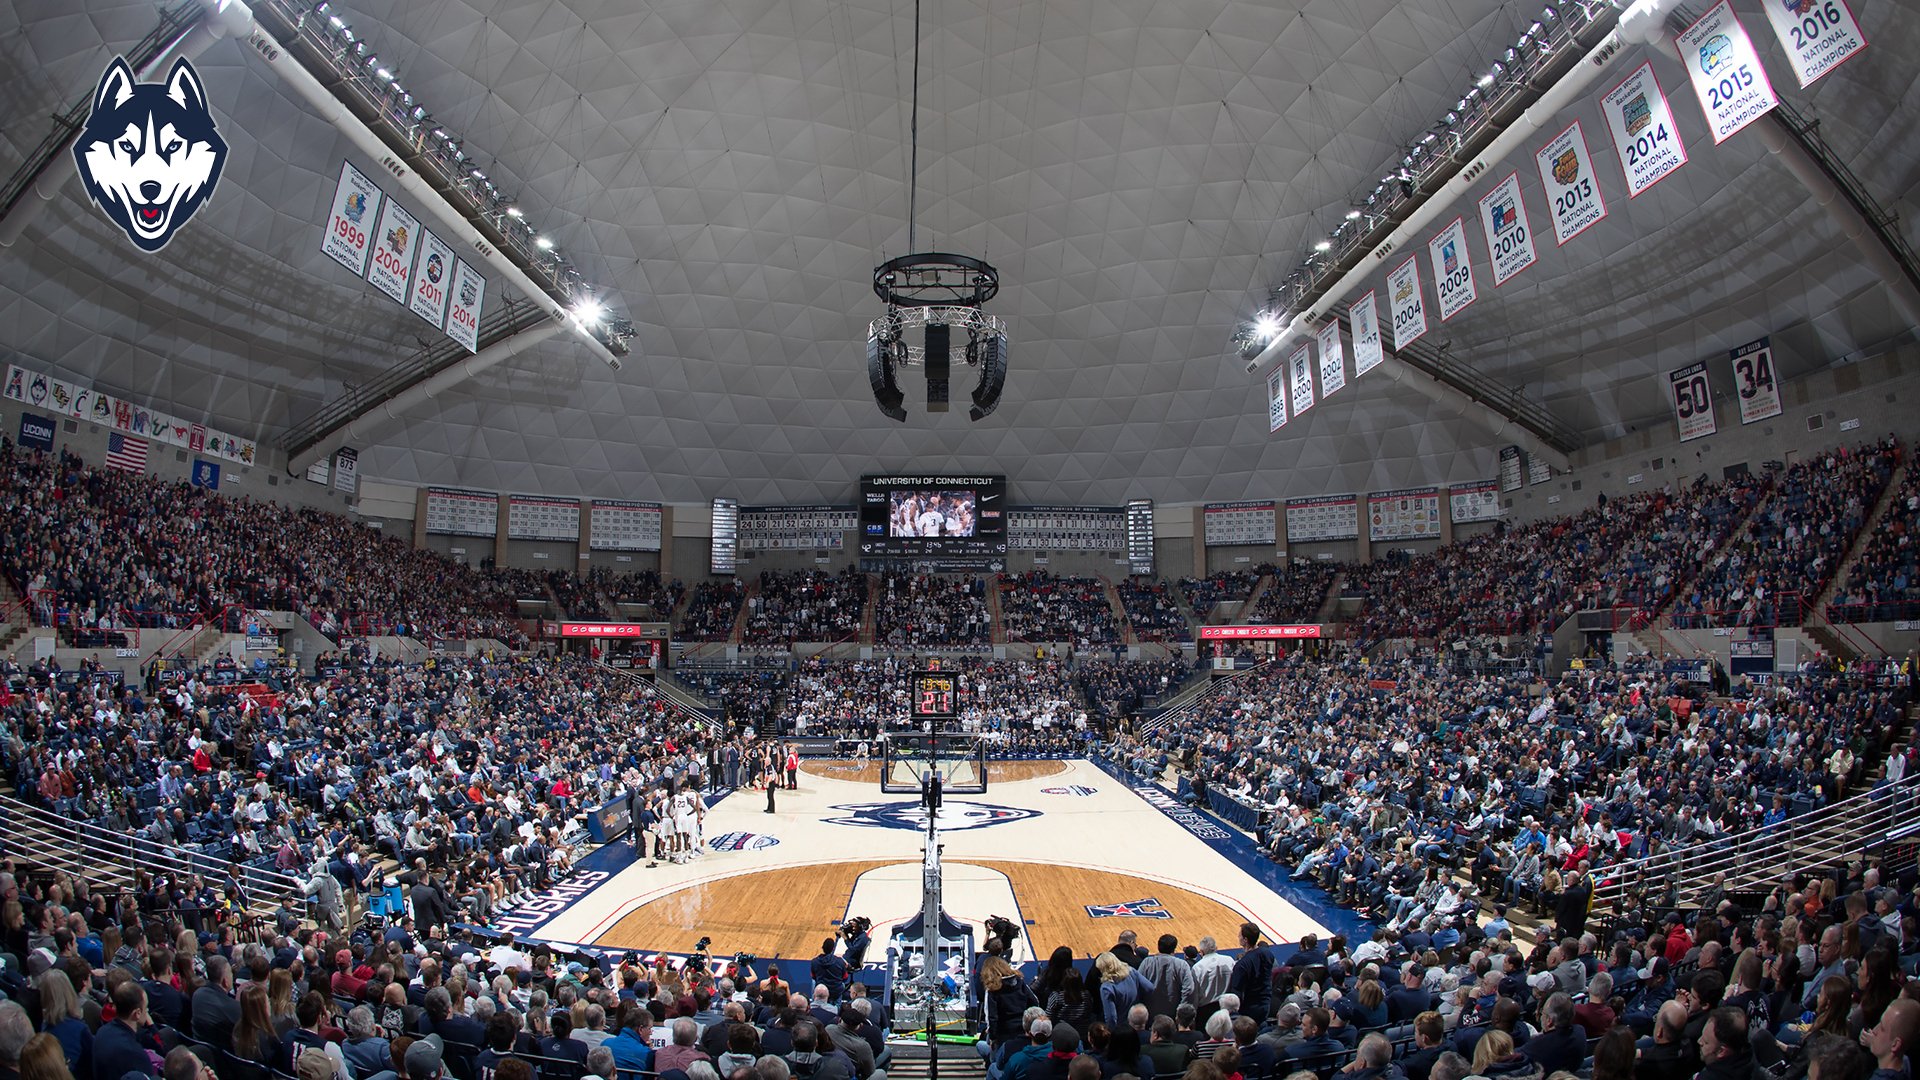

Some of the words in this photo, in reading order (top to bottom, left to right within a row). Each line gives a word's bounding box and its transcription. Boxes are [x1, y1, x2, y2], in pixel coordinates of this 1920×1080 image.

[1681, 26, 1699, 43] UConn
[1699, 4, 1725, 28] Women's
[1692, 19, 1721, 46] Basketball
[1791, 1, 1840, 50] 2016
[1803, 28, 1847, 62] NATIONAL
[1806, 38, 1857, 77] CHAMPIONS
[1606, 88, 1623, 104] UConn
[1623, 68, 1646, 89] Women's
[1616, 80, 1642, 106] Basketball
[1708, 64, 1753, 110] 2015
[1718, 89, 1760, 120] NATIONAL
[1720, 98, 1768, 135] CHAMPIONS
[1626, 122, 1668, 166] 2014
[1634, 146, 1672, 176] NATIONAL
[1635, 156, 1678, 190] CHAMPIONS
[1556, 178, 1592, 216] 2013
[1562, 201, 1594, 226] NATIONAL
[1562, 209, 1600, 238] CHAMPIONS
[334, 216, 364, 249] 1999
[1494, 226, 1525, 261] 2010
[327, 245, 360, 272] CHAMPIONS
[332, 236, 359, 260] NATIONAL
[1499, 246, 1526, 270] NATIONAL
[376, 247, 408, 280] 2004
[1499, 254, 1532, 280] CHAMPIONS
[372, 276, 402, 300] CHAMPIONS
[376, 268, 401, 289] NATIONAL
[1440, 266, 1469, 298] 2009
[419, 279, 442, 306] 2011
[1444, 286, 1468, 306] NATIONAL
[1444, 294, 1472, 316] CHAMPIONS
[414, 304, 440, 325] CHAMPIONS
[418, 296, 439, 316] NATIONAL
[453, 305, 476, 330] 2014
[1395, 300, 1421, 330] 2004
[450, 329, 473, 347] CHAMPIONS
[452, 322, 472, 338] NATIONAL
[1400, 319, 1420, 336] NATIONAL
[1322, 358, 1342, 380] 2002
[1736, 352, 1774, 399] 34
[1294, 379, 1310, 400] 2000
[1675, 376, 1710, 418] 50
[23, 424, 52, 438] UCONN
[340, 458, 354, 470] 873
[772, 520, 780, 528] 21
[786, 520, 795, 528] 52
[862, 544, 872, 552] 42
[996, 544, 1006, 553] 43
[923, 678, 950, 691] 13:46
[1687, 672, 1699, 680] 110
[922, 692, 948, 713] 21
[678, 800, 686, 808] 23
[494, 870, 610, 937] HUSKIES
